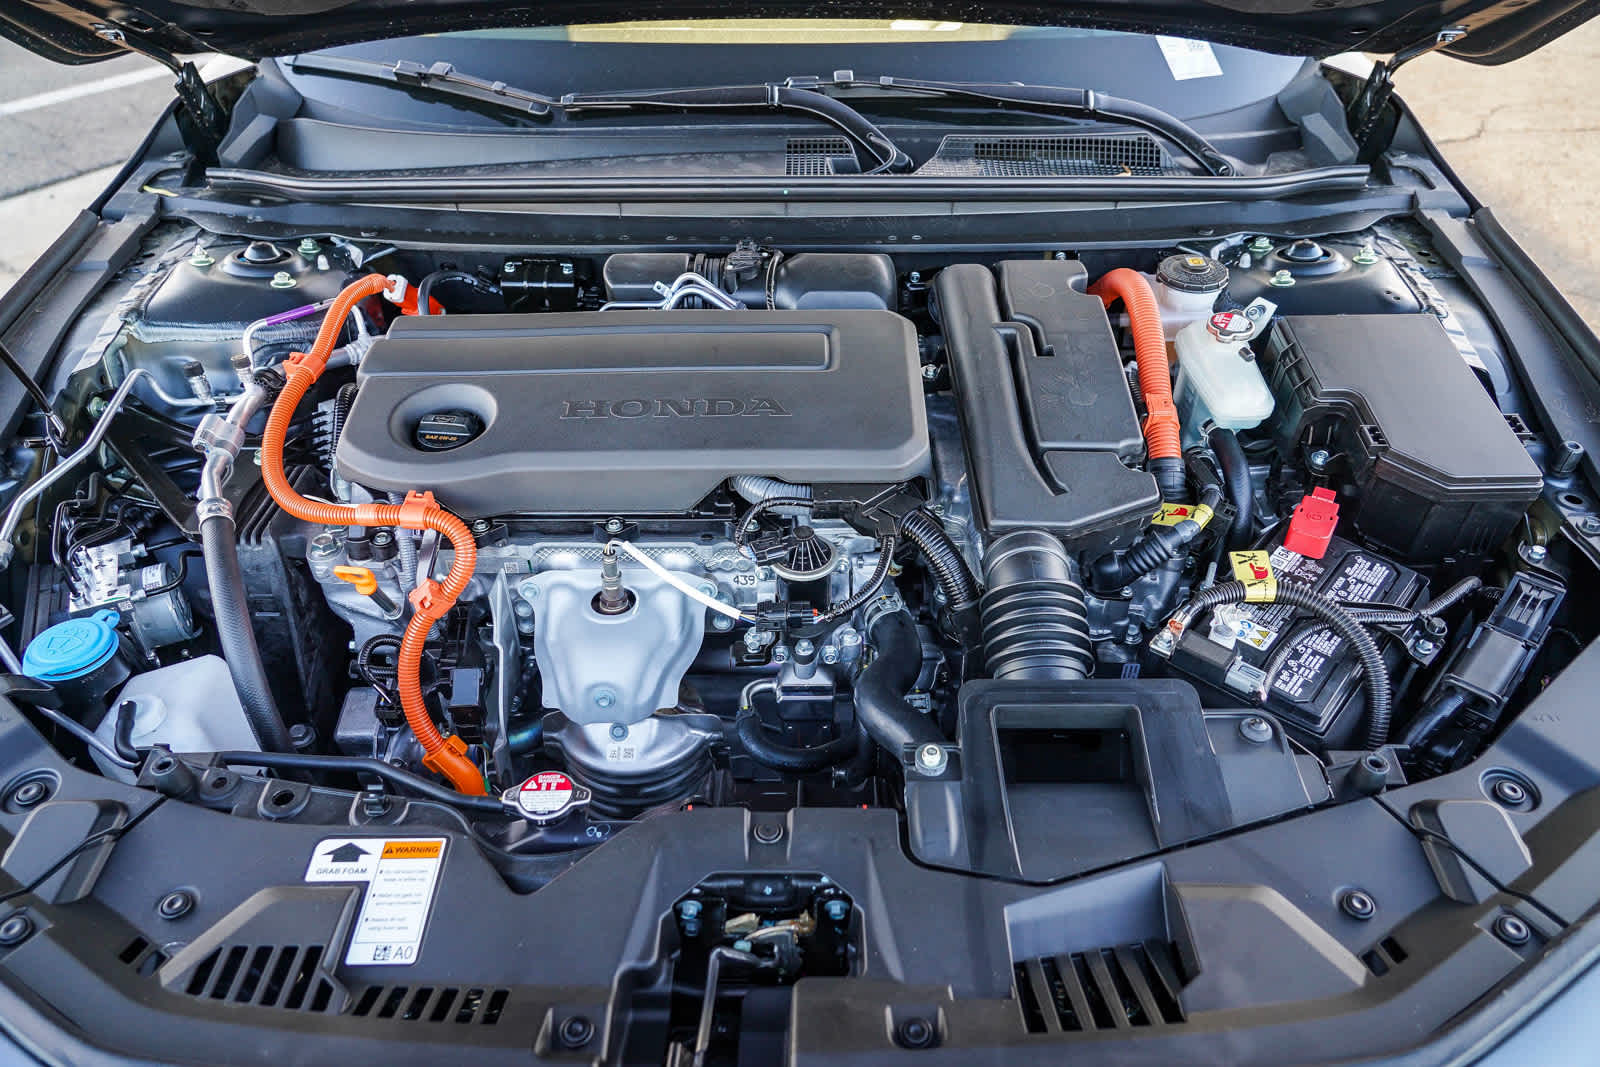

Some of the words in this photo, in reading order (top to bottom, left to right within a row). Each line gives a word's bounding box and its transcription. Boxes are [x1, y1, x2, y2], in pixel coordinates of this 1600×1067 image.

[560, 399, 792, 418] HONDA
[733, 575, 755, 585] 439
[395, 846, 439, 854] WARNING
[342, 867, 368, 875] FOAM
[393, 945, 413, 960] A0
